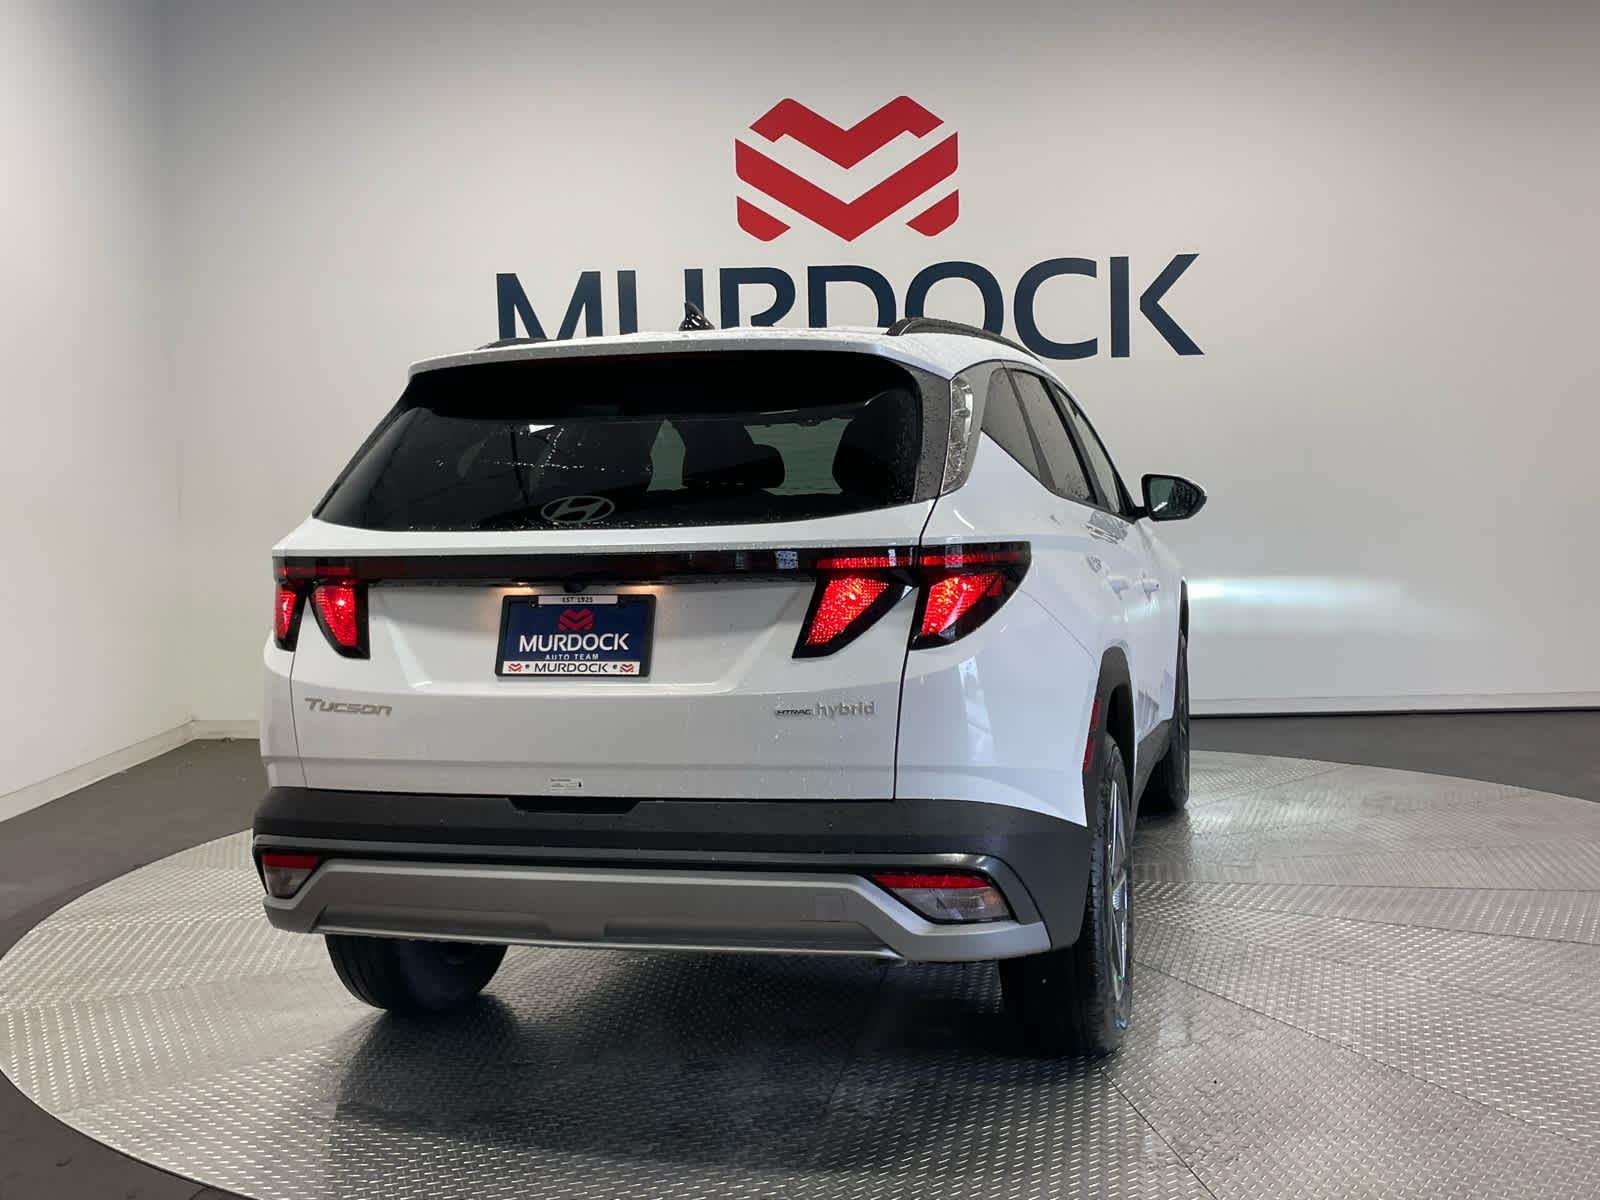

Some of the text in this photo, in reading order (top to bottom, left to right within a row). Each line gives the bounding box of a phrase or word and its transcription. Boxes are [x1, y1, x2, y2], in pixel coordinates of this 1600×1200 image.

[496, 254, 1205, 359] MURDOCK
[518, 632, 630, 653] MURDOCK
[544, 653, 600, 661] AUTO TEAM
[534, 662, 608, 673] MURDOCK
[815, 700, 876, 719] hybrid
